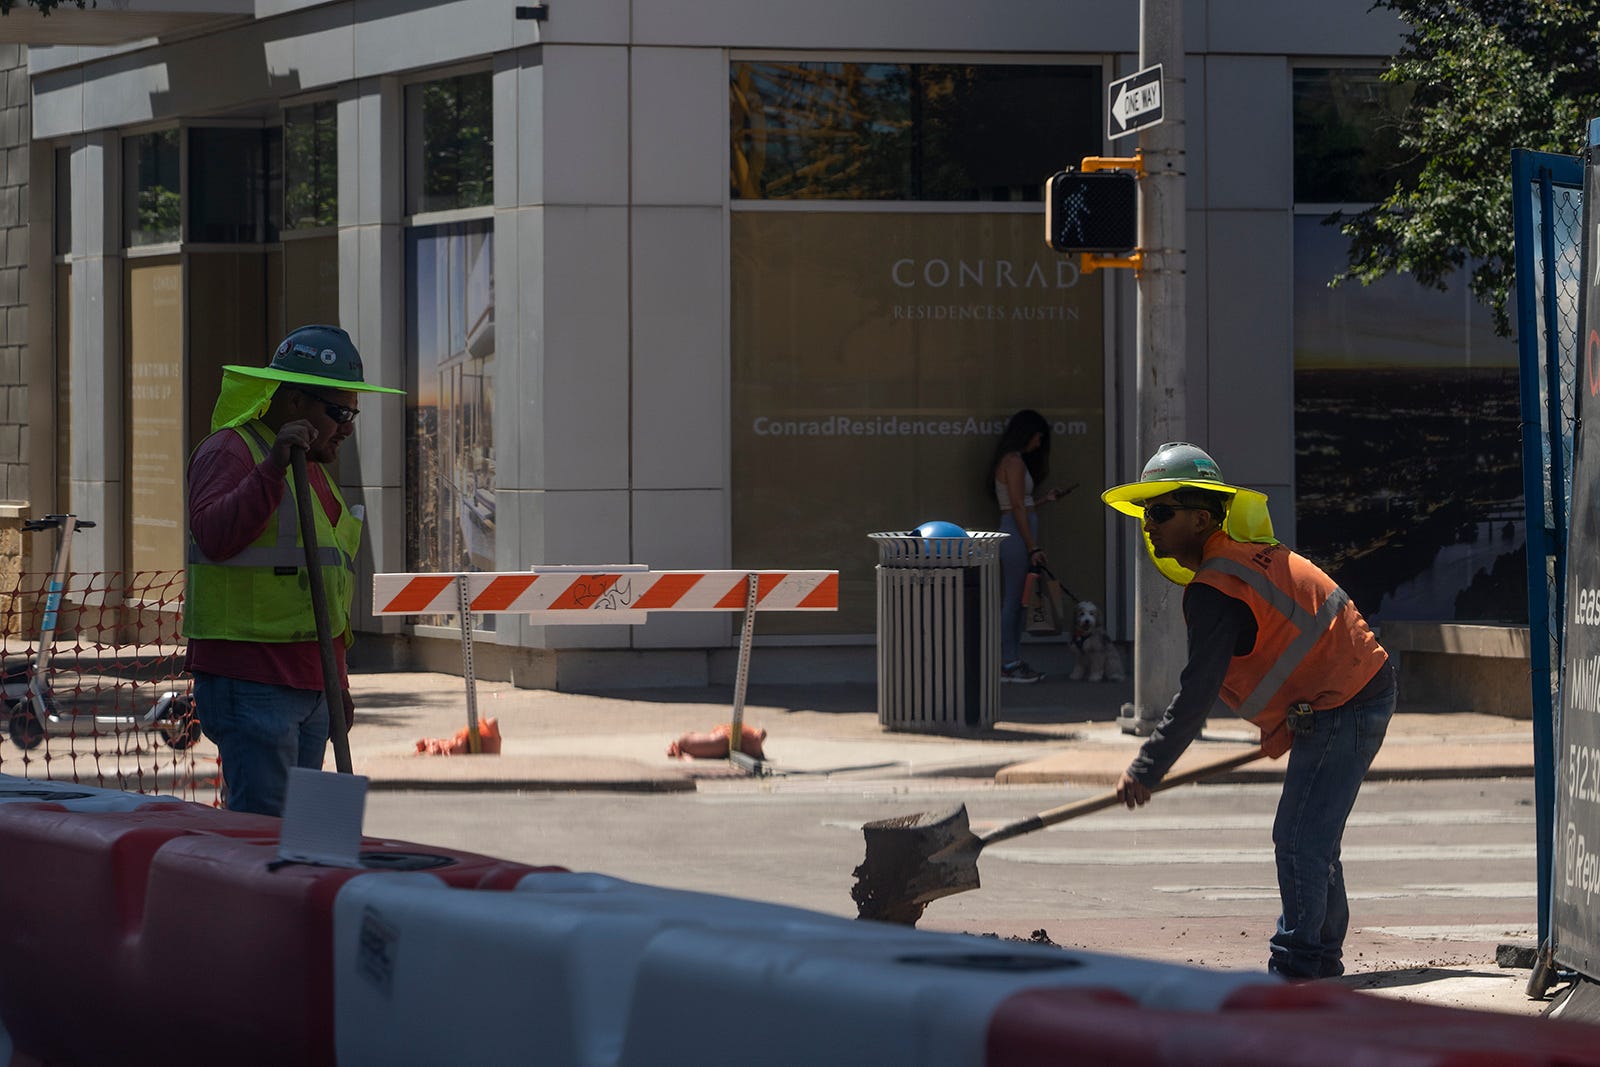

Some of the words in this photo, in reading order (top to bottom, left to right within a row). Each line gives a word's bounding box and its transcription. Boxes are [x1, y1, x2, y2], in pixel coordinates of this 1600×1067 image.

[1124, 91, 1140, 115] ONE
[1142, 84, 1157, 109] WAY
[891, 258, 1080, 289] CONRAD
[893, 305, 1005, 321] RESIDENCES
[1012, 306, 1080, 321] AUSTIN
